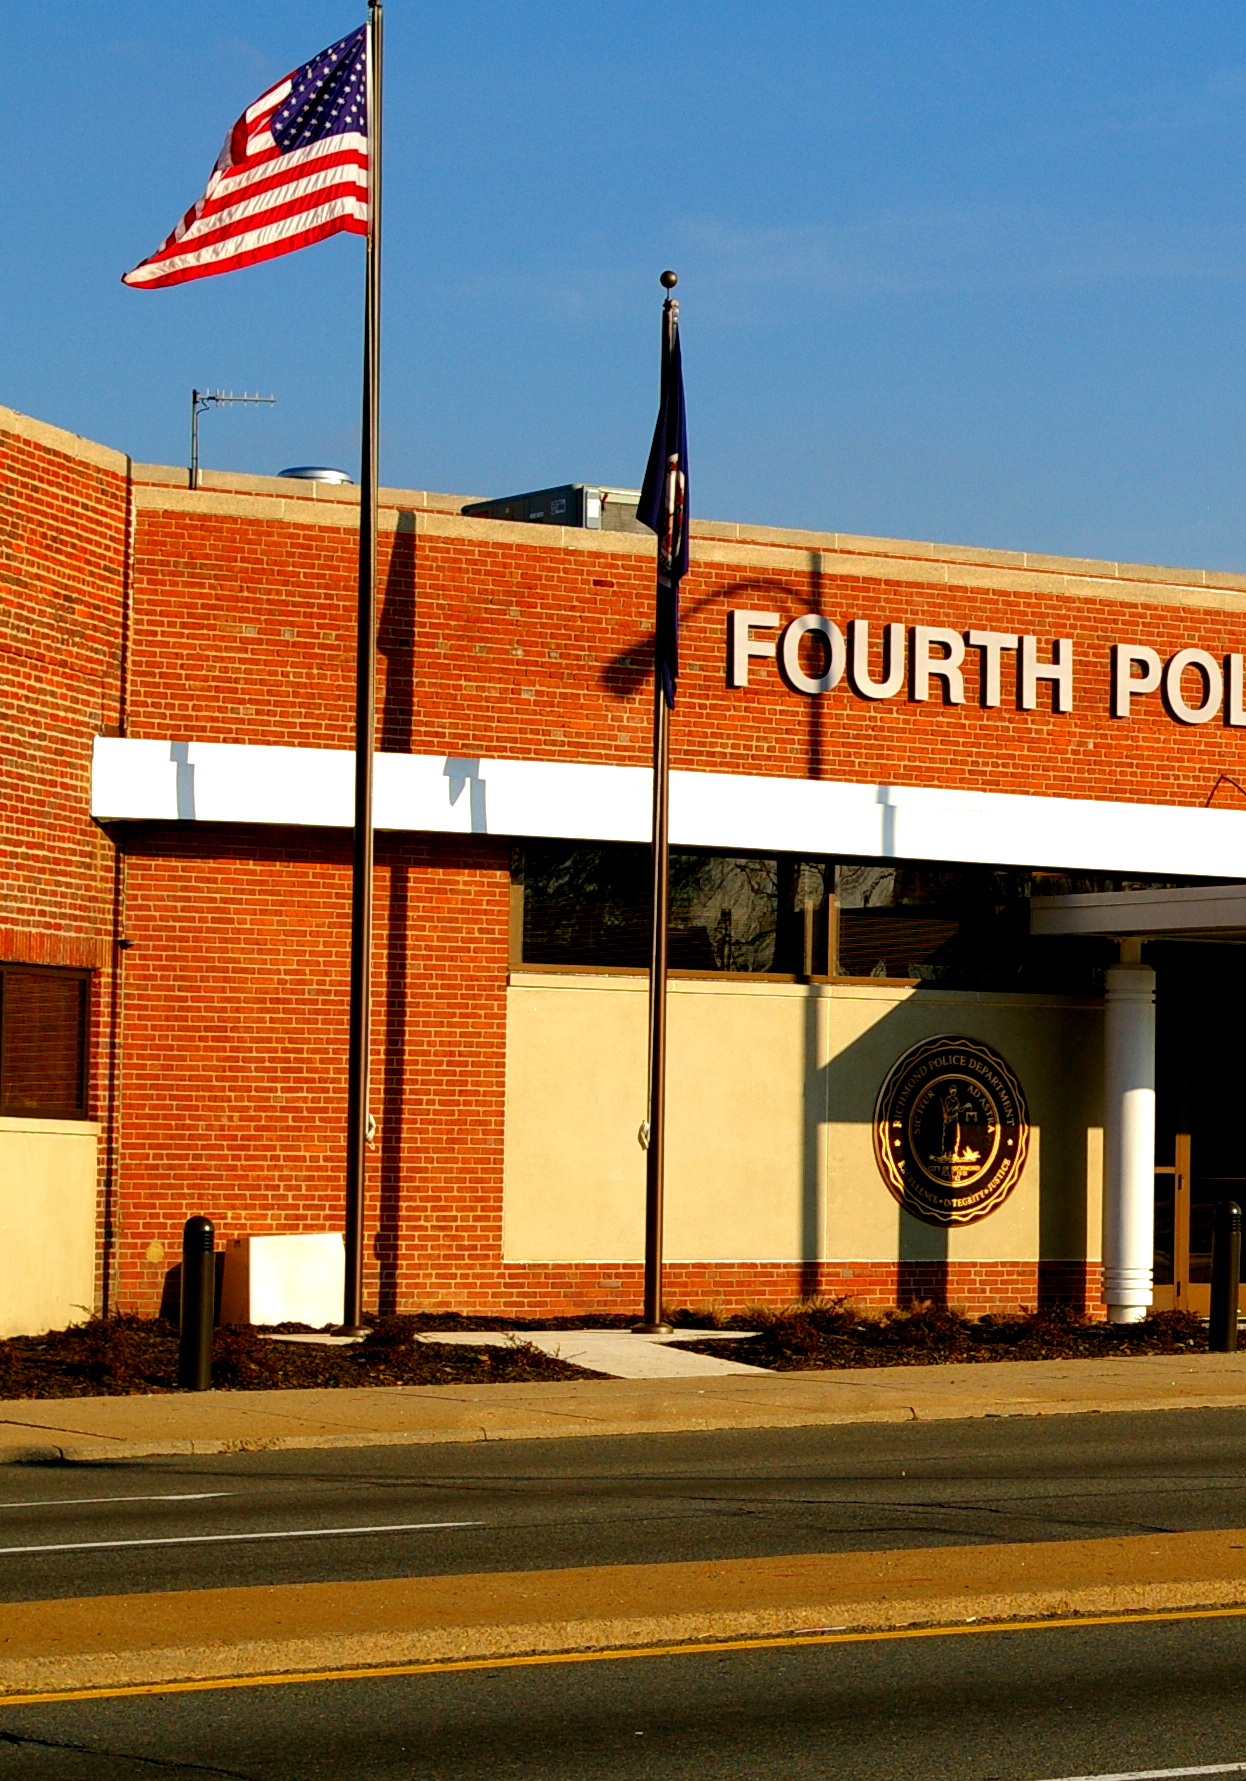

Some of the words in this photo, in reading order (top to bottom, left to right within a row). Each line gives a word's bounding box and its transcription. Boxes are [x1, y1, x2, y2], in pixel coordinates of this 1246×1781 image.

[731, 608, 1074, 713] FOURTH
[892, 1064, 928, 1129] RICHMOND
[928, 1055, 967, 1071] POLICE
[967, 1057, 1016, 1127] DEPARTMENT
[916, 1089, 936, 1115] ITUR
[966, 1084, 981, 1098] AD
[978, 1097, 996, 1134] ASTRA
[913, 1116, 922, 1135] SIC
[943, 1189, 986, 1208] INTEGRITY
[987, 1157, 1012, 1193] JUSTICE
